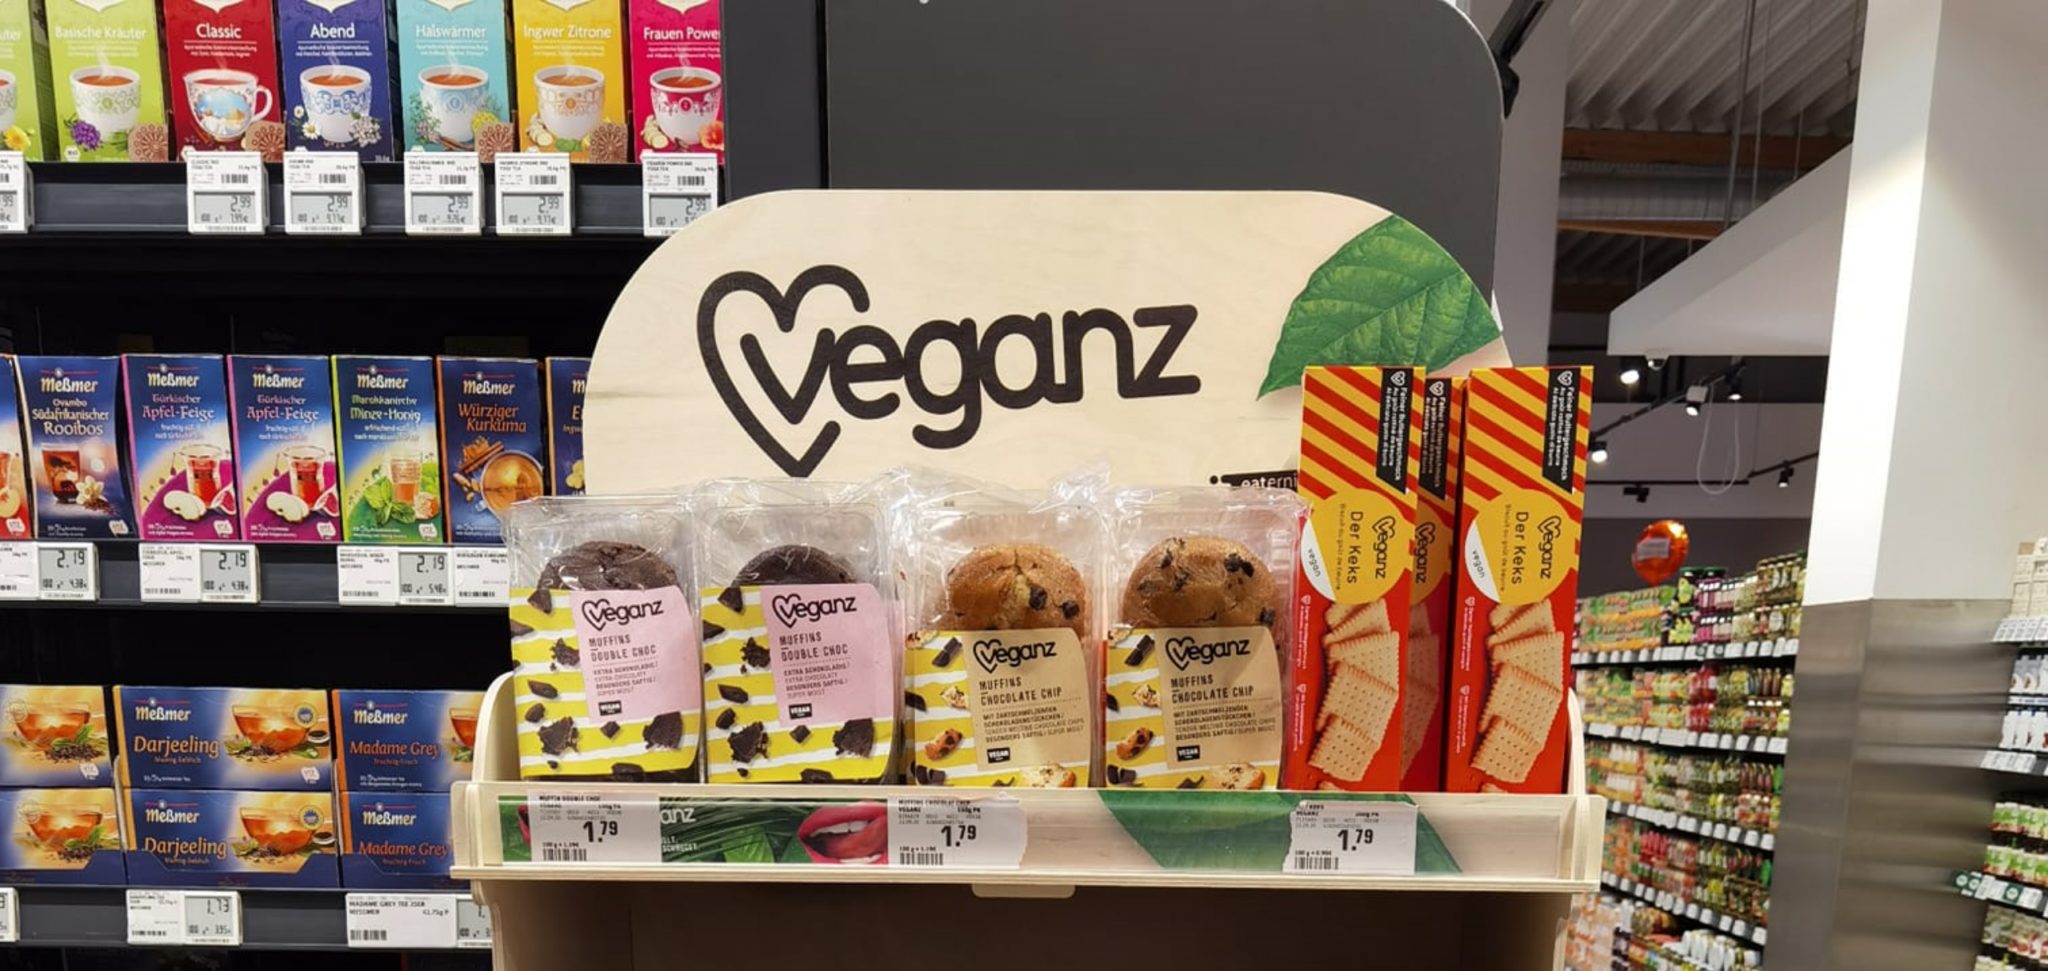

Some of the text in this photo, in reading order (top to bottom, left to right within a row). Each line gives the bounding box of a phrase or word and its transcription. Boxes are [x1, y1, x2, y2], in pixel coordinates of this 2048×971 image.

[55, 26, 146, 40] Basische Kräuter
[196, 23, 242, 39] Classic
[311, 23, 356, 39] Abend
[416, 24, 487, 39] Halswärmer
[523, 24, 611, 41] Ingwer Zitrone
[643, 26, 683, 40] Frauen
[231, 195, 252, 213] 2.99
[327, 195, 349, 213] 2.99
[448, 196, 469, 213] 2.99
[538, 197, 560, 214] 2.99
[41, 376, 98, 393] Meßmer
[147, 372, 200, 387] Meßmer
[252, 373, 305, 389] Meßmer
[357, 373, 409, 389] Meßmer
[463, 380, 516, 395] Meßmer
[32, 407, 109, 422] Südafrikanischer
[142, 404, 216, 423] Apfel-Feige
[247, 406, 319, 424] Apfel-Feige
[350, 407, 422, 423] Minze-Honig
[457, 403, 519, 420] Würziger
[43, 420, 104, 436] Rooibos
[466, 418, 527, 433] Kurkuma
[1346, 511, 1364, 584] Der Keks
[1511, 511, 1529, 585] Der Keks
[57, 550, 85, 569] 2.19
[219, 552, 247, 570] 2.19
[416, 555, 445, 574] 2.19
[1307, 548, 1322, 577] vegan
[1472, 549, 1486, 579] vegan
[589, 634, 631, 647] MUFFINS
[779, 631, 822, 646] MUFFINS
[590, 644, 657, 662] DOUBLE CHOC
[781, 643, 848, 662] DOUBLE CHOC
[979, 676, 1022, 691] MUFFINS
[1171, 674, 1214, 688] MUFFINS
[981, 686, 1062, 706] CHOCOLATE CHIP
[1172, 685, 1254, 704] CHOCOLATE CHIP
[135, 706, 192, 721] Meßmer
[353, 709, 408, 725] Meßmer
[133, 735, 219, 759] Darjeeling
[350, 739, 440, 760] Madame Grey
[145, 808, 200, 824] Meßmer
[362, 811, 417, 826] Meßmer
[582, 820, 618, 843] 1.79
[941, 824, 977, 847] 1.79
[1337, 828, 1374, 851] 1.79
[144, 836, 227, 860] Darjeeling
[359, 840, 449, 859] Madame Grey
